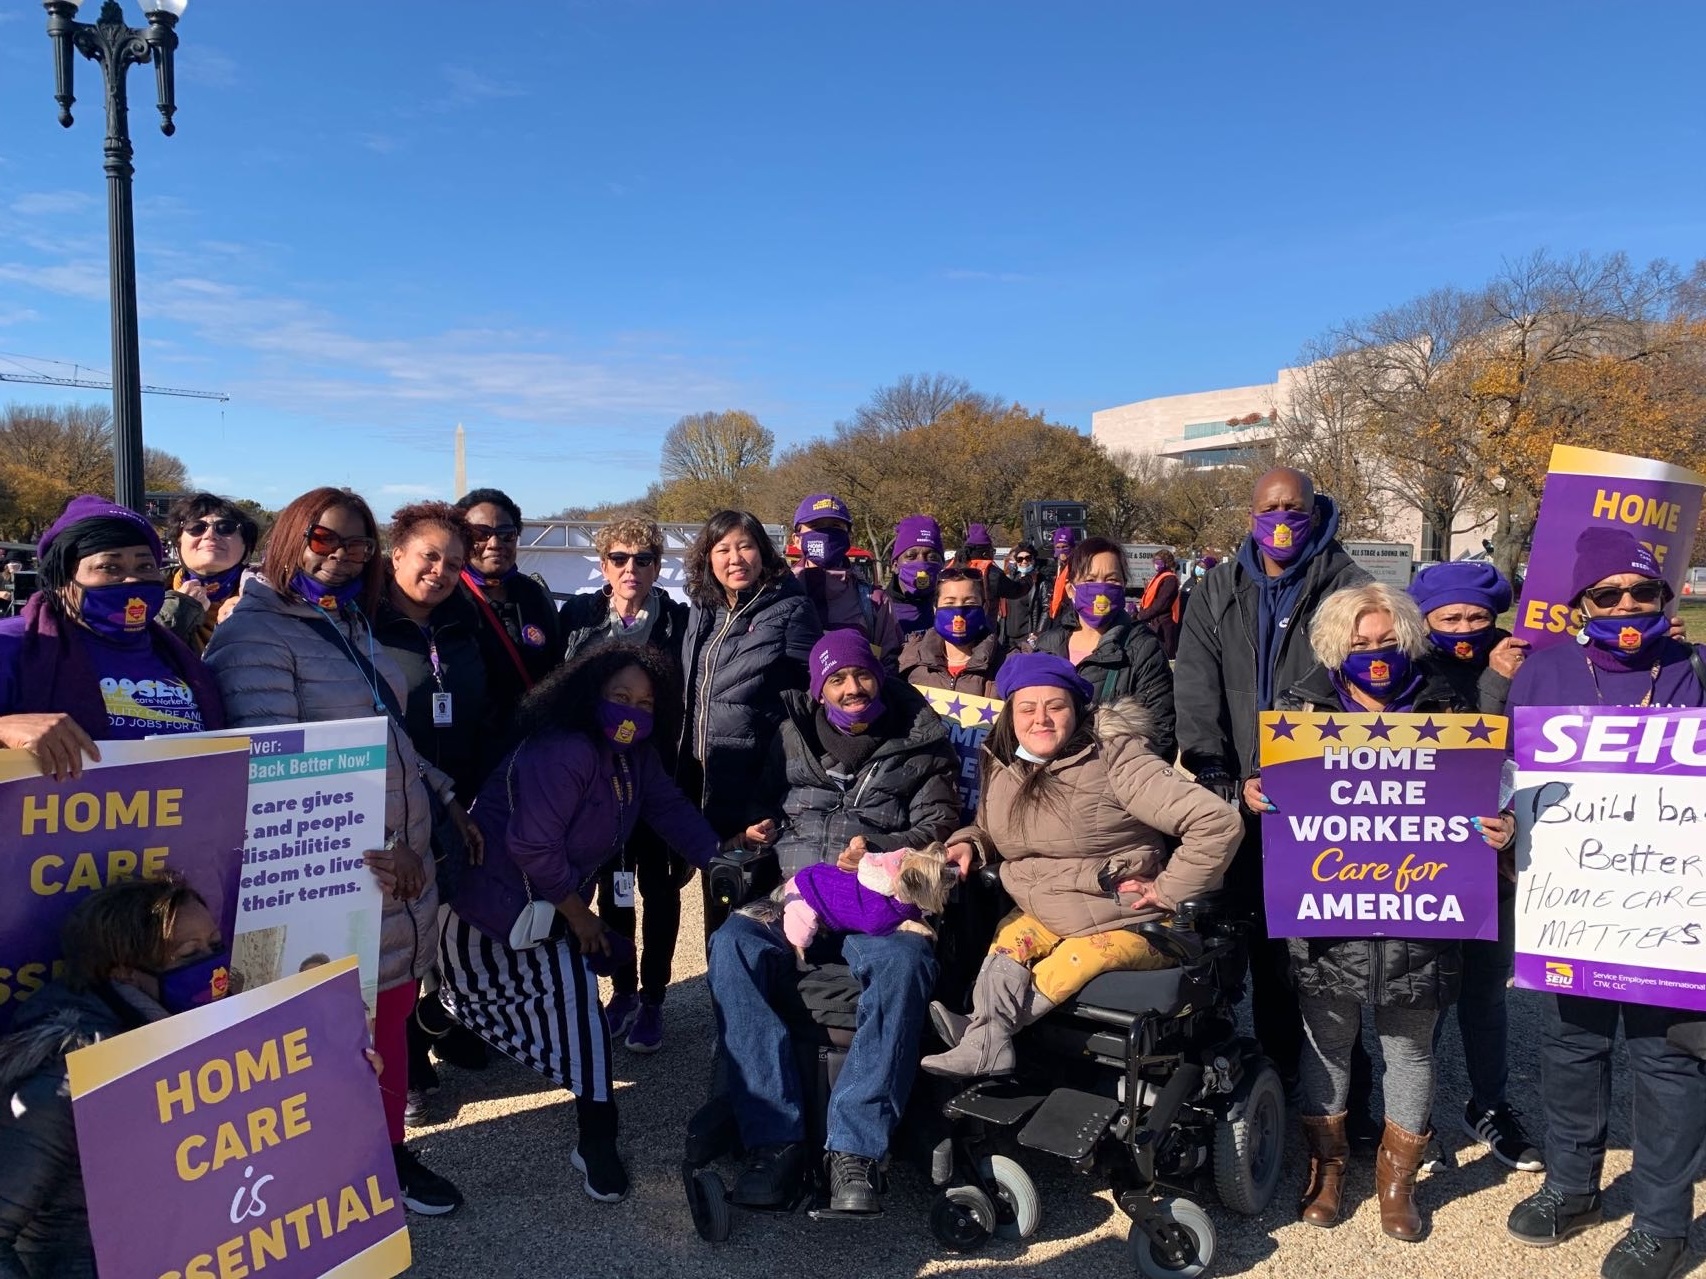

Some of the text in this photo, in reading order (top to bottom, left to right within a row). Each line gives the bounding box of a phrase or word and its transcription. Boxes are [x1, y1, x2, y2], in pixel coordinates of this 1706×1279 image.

[1592, 489, 1682, 532] HOME
[129, 718, 162, 728] JOBS
[166, 720, 189, 731] FOR
[1534, 715, 1706, 766] SEIU
[249, 751, 370, 779] Back Better Now!
[1323, 746, 1437, 771] HOME
[252, 790, 354, 815] care gives
[1330, 780, 1426, 805] CARE
[21, 788, 184, 835] HOME
[253, 819, 292, 840] and
[297, 810, 365, 838] people
[1288, 815, 1470, 842] WORKERS
[30, 846, 170, 895] CARE
[241, 856, 364, 889] edom to live
[1311, 847, 1448, 892] Care for
[242, 880, 362, 912] their terms.
[1296, 893, 1465, 922] AMERICA
[1525, 872, 1706, 914] HOME CARE
[1538, 919, 1702, 951] MATTERS
[1545, 974, 1573, 985] SEIU
[1593, 971, 1706, 991] Service Employees International
[1612, 982, 1627, 991] CLC
[155, 1026, 313, 1124] HOME
[174, 1092, 313, 1183] CARE
[229, 1165, 274, 1224] is
[157, 1175, 395, 1279] SENTIAL
